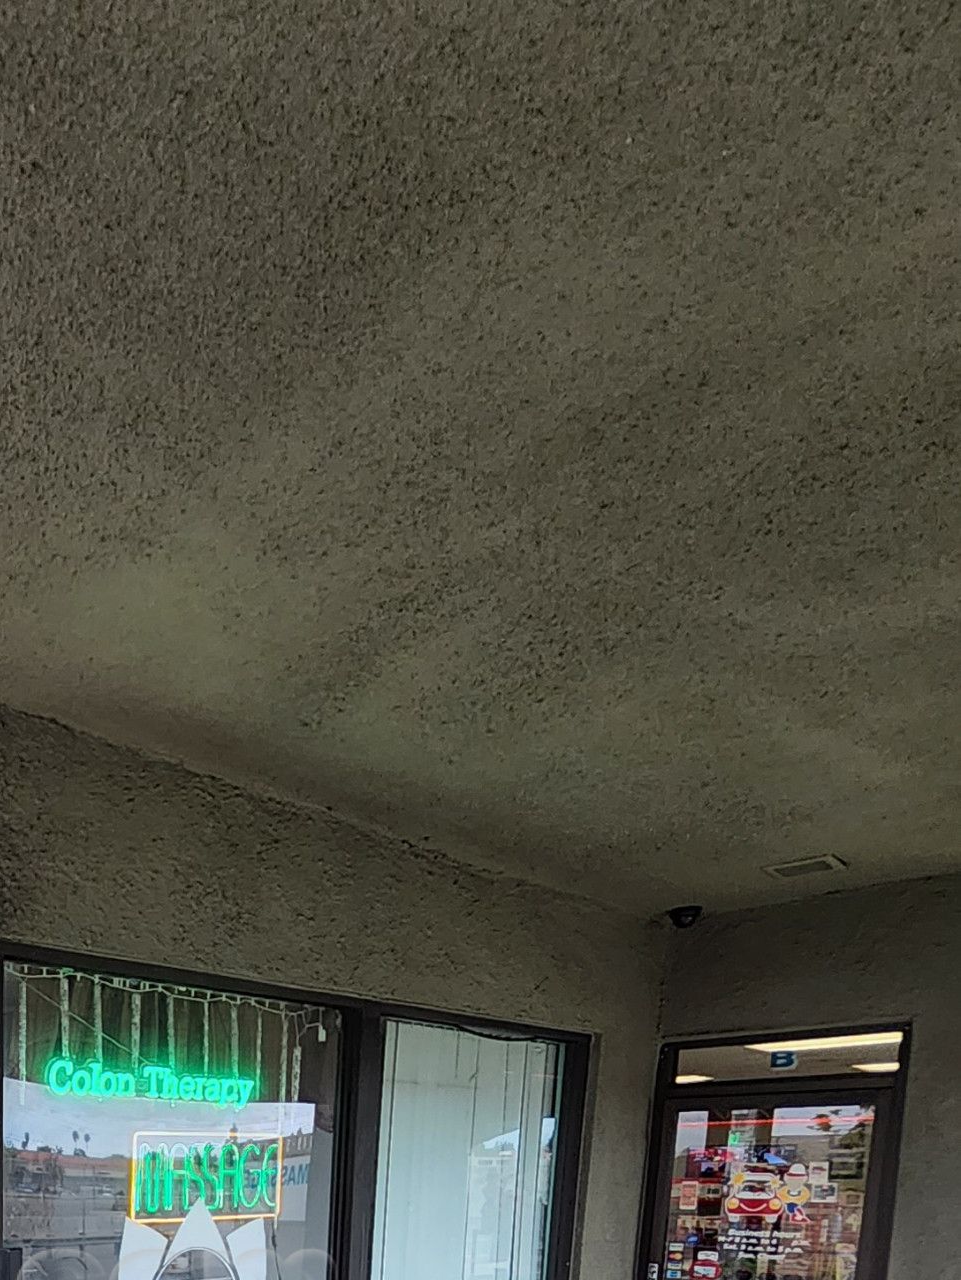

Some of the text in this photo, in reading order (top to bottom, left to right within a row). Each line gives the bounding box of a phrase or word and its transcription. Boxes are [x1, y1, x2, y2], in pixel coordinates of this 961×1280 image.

[47, 1058, 255, 1110] Colon Therapy
[770, 1050, 797, 1069] B
[135, 1142, 280, 1214] MASSAGE
